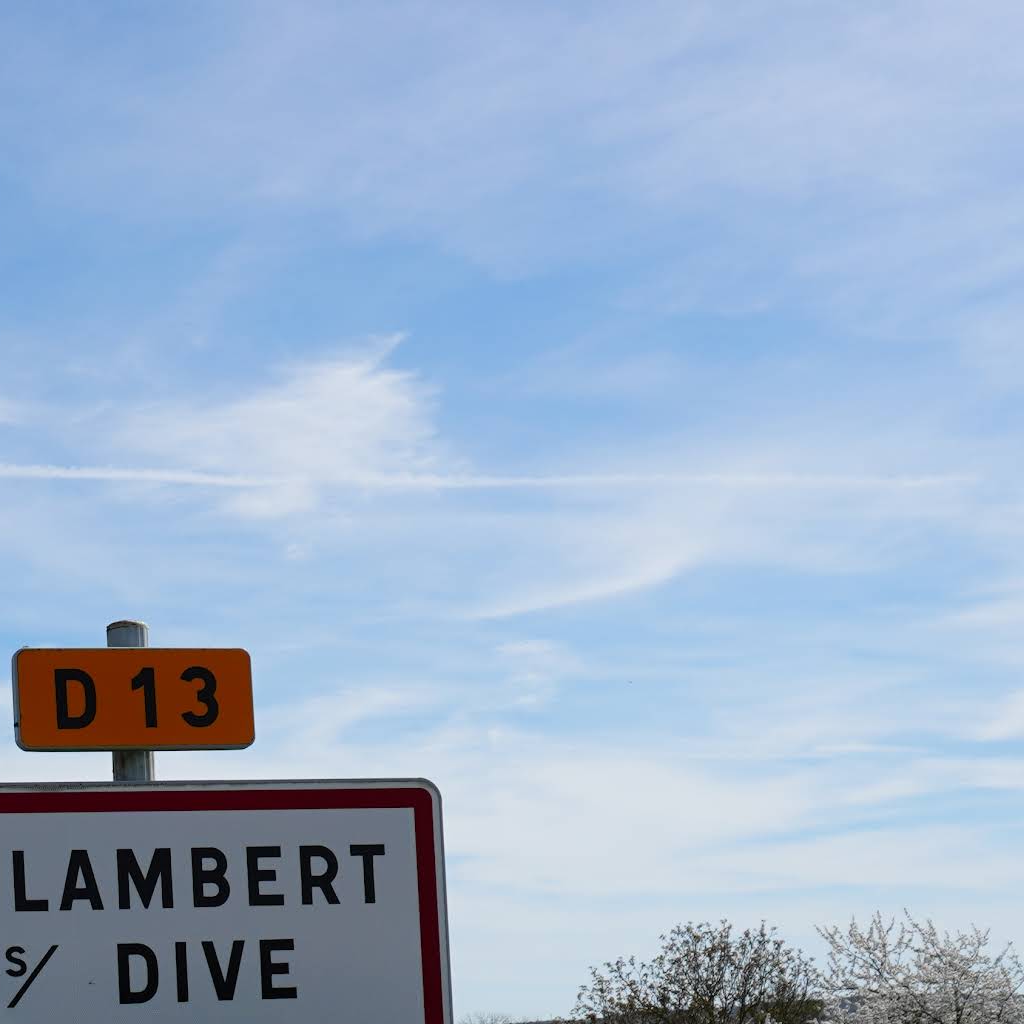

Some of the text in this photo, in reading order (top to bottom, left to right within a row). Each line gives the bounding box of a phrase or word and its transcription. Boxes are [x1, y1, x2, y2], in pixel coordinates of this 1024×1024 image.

[54, 665, 220, 730] D 13
[11, 843, 386, 913] LAMBERT
[116, 938, 299, 1005] DIVE
